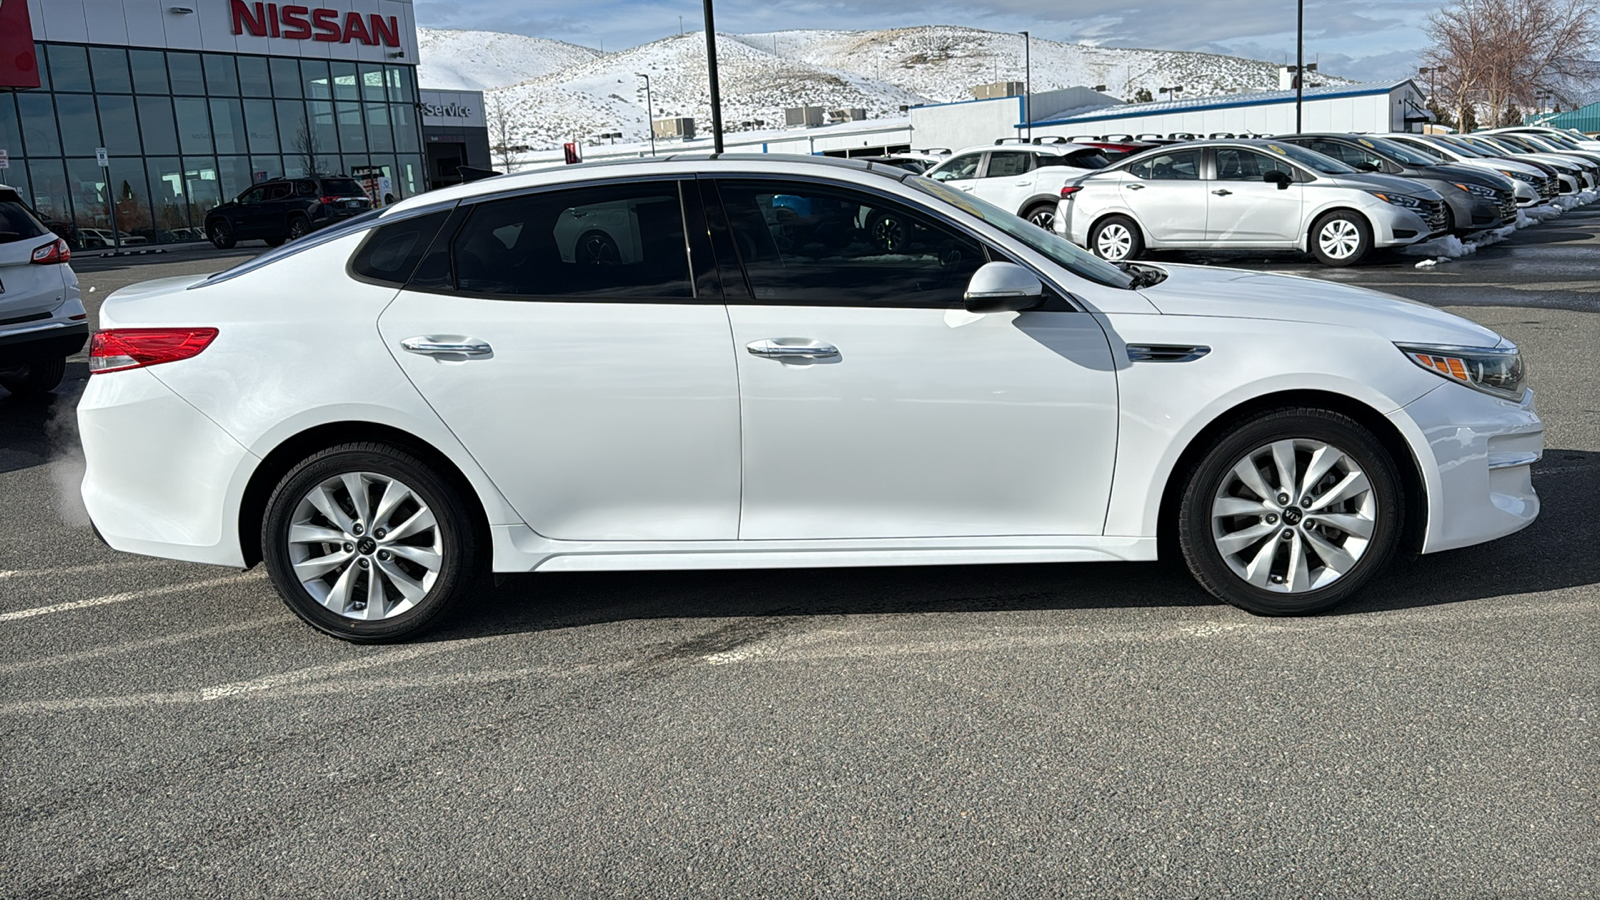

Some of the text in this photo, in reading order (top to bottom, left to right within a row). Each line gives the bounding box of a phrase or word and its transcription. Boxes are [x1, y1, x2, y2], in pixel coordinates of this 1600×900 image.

[231, 0, 400, 47] NISSAN
[426, 103, 472, 117] Service
[1286, 510, 1300, 522] KIA
[360, 540, 374, 553] KIA
